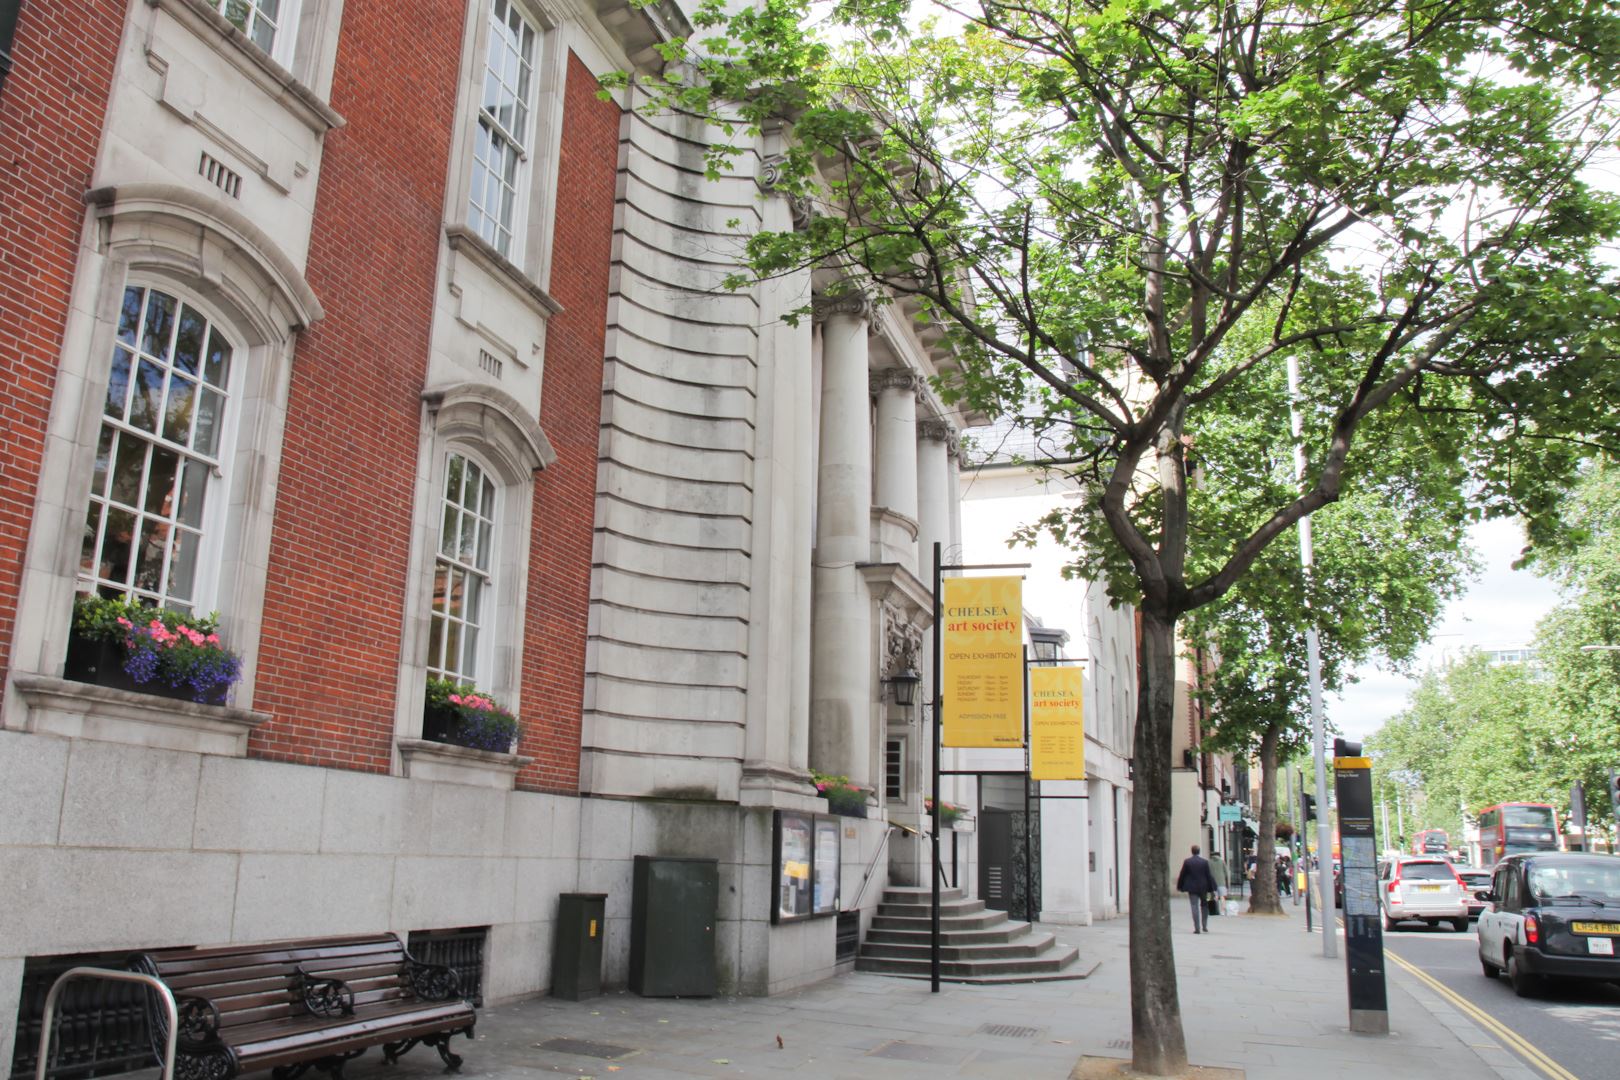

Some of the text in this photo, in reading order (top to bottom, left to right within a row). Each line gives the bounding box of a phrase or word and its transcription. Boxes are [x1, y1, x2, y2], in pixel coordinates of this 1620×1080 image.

[948, 606, 1008, 617] CHELSEA
[948, 619, 1017, 633] art society
[949, 651, 1016, 660] OPEN EXHIBITION
[1033, 690, 1074, 698] CHELSEA
[1033, 699, 1079, 709] art society
